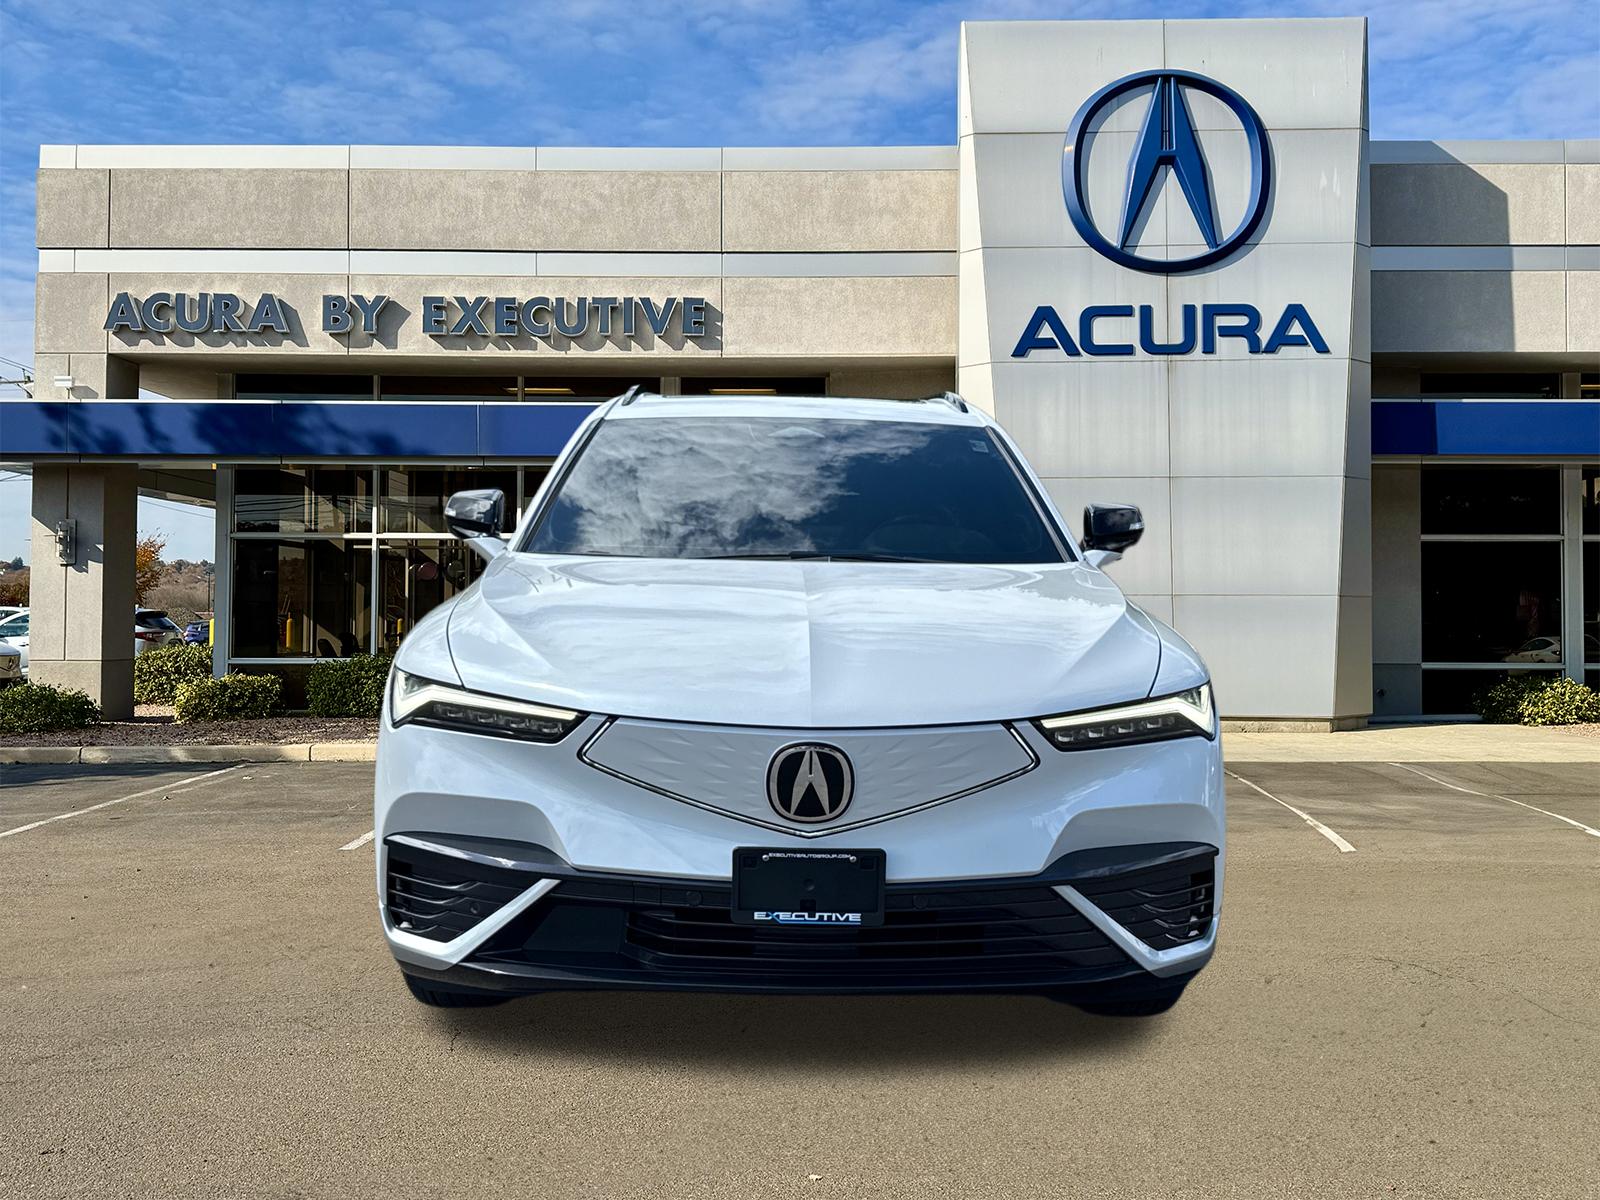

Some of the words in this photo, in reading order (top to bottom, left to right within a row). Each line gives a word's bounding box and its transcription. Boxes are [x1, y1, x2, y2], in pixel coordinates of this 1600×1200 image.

[104, 292, 289, 334] ACURA
[322, 294, 389, 335] BY
[422, 295, 708, 338] EXECUTIVE
[1011, 303, 1332, 357] ACURA
[754, 911, 861, 922] EXECUTIVE
